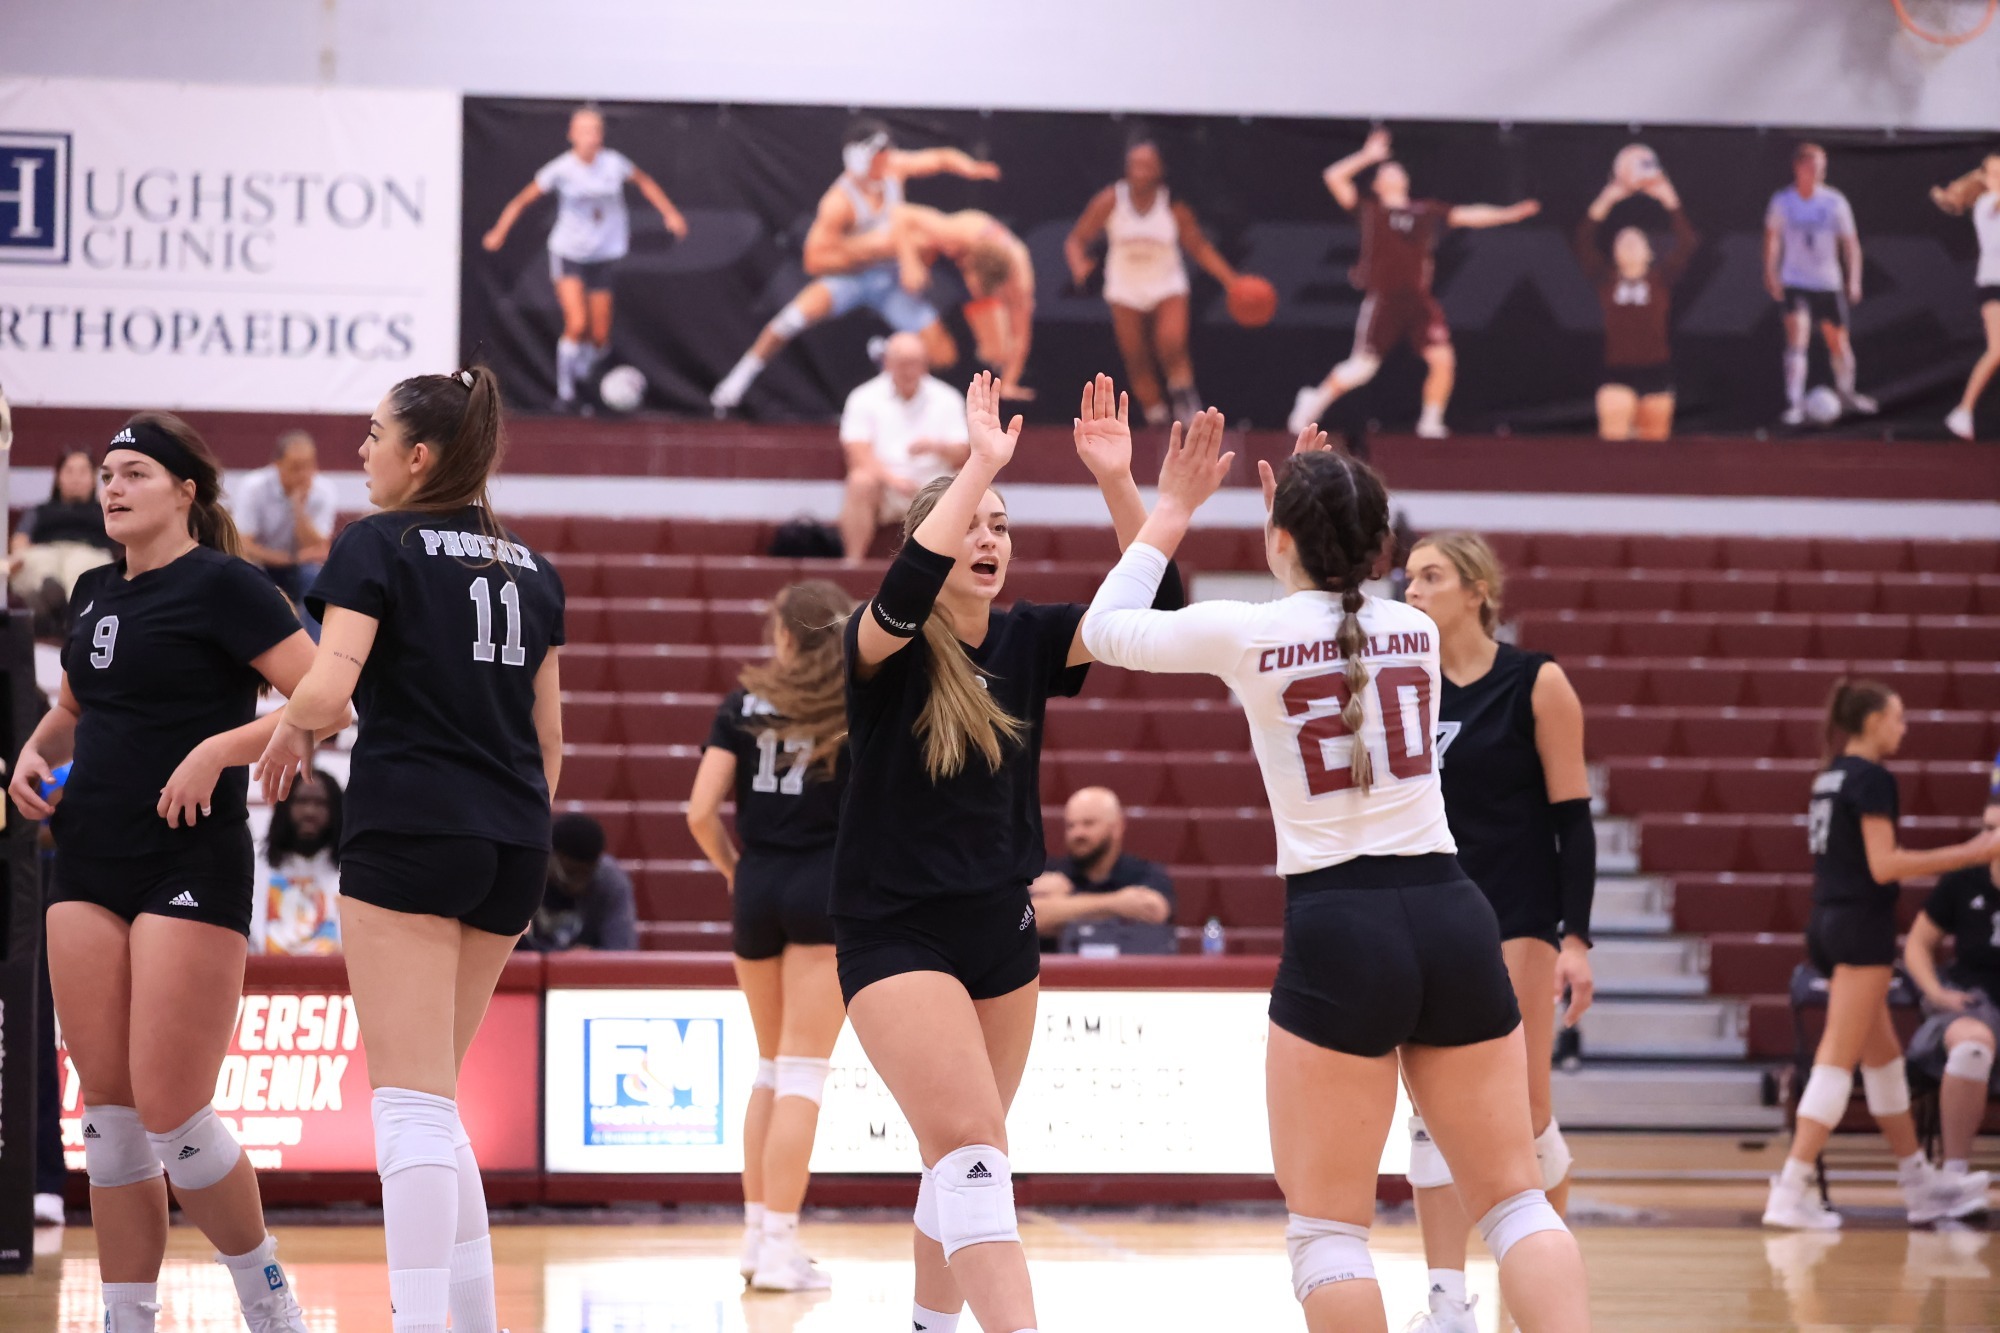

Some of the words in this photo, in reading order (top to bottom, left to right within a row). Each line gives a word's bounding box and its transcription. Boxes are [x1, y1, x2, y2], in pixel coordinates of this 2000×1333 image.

[82, 224, 276, 274] CLINIC
[90, 614, 119, 669] 9
[469, 577, 526, 666] 11
[1258, 632, 1431, 673] CUMBLAND
[1280, 664, 1434, 798] 20
[752, 728, 816, 795] 17
[168, 900, 199, 908] adidas
[210, 1054, 349, 1112] OENIX
[966, 1171, 993, 1179] adidas
